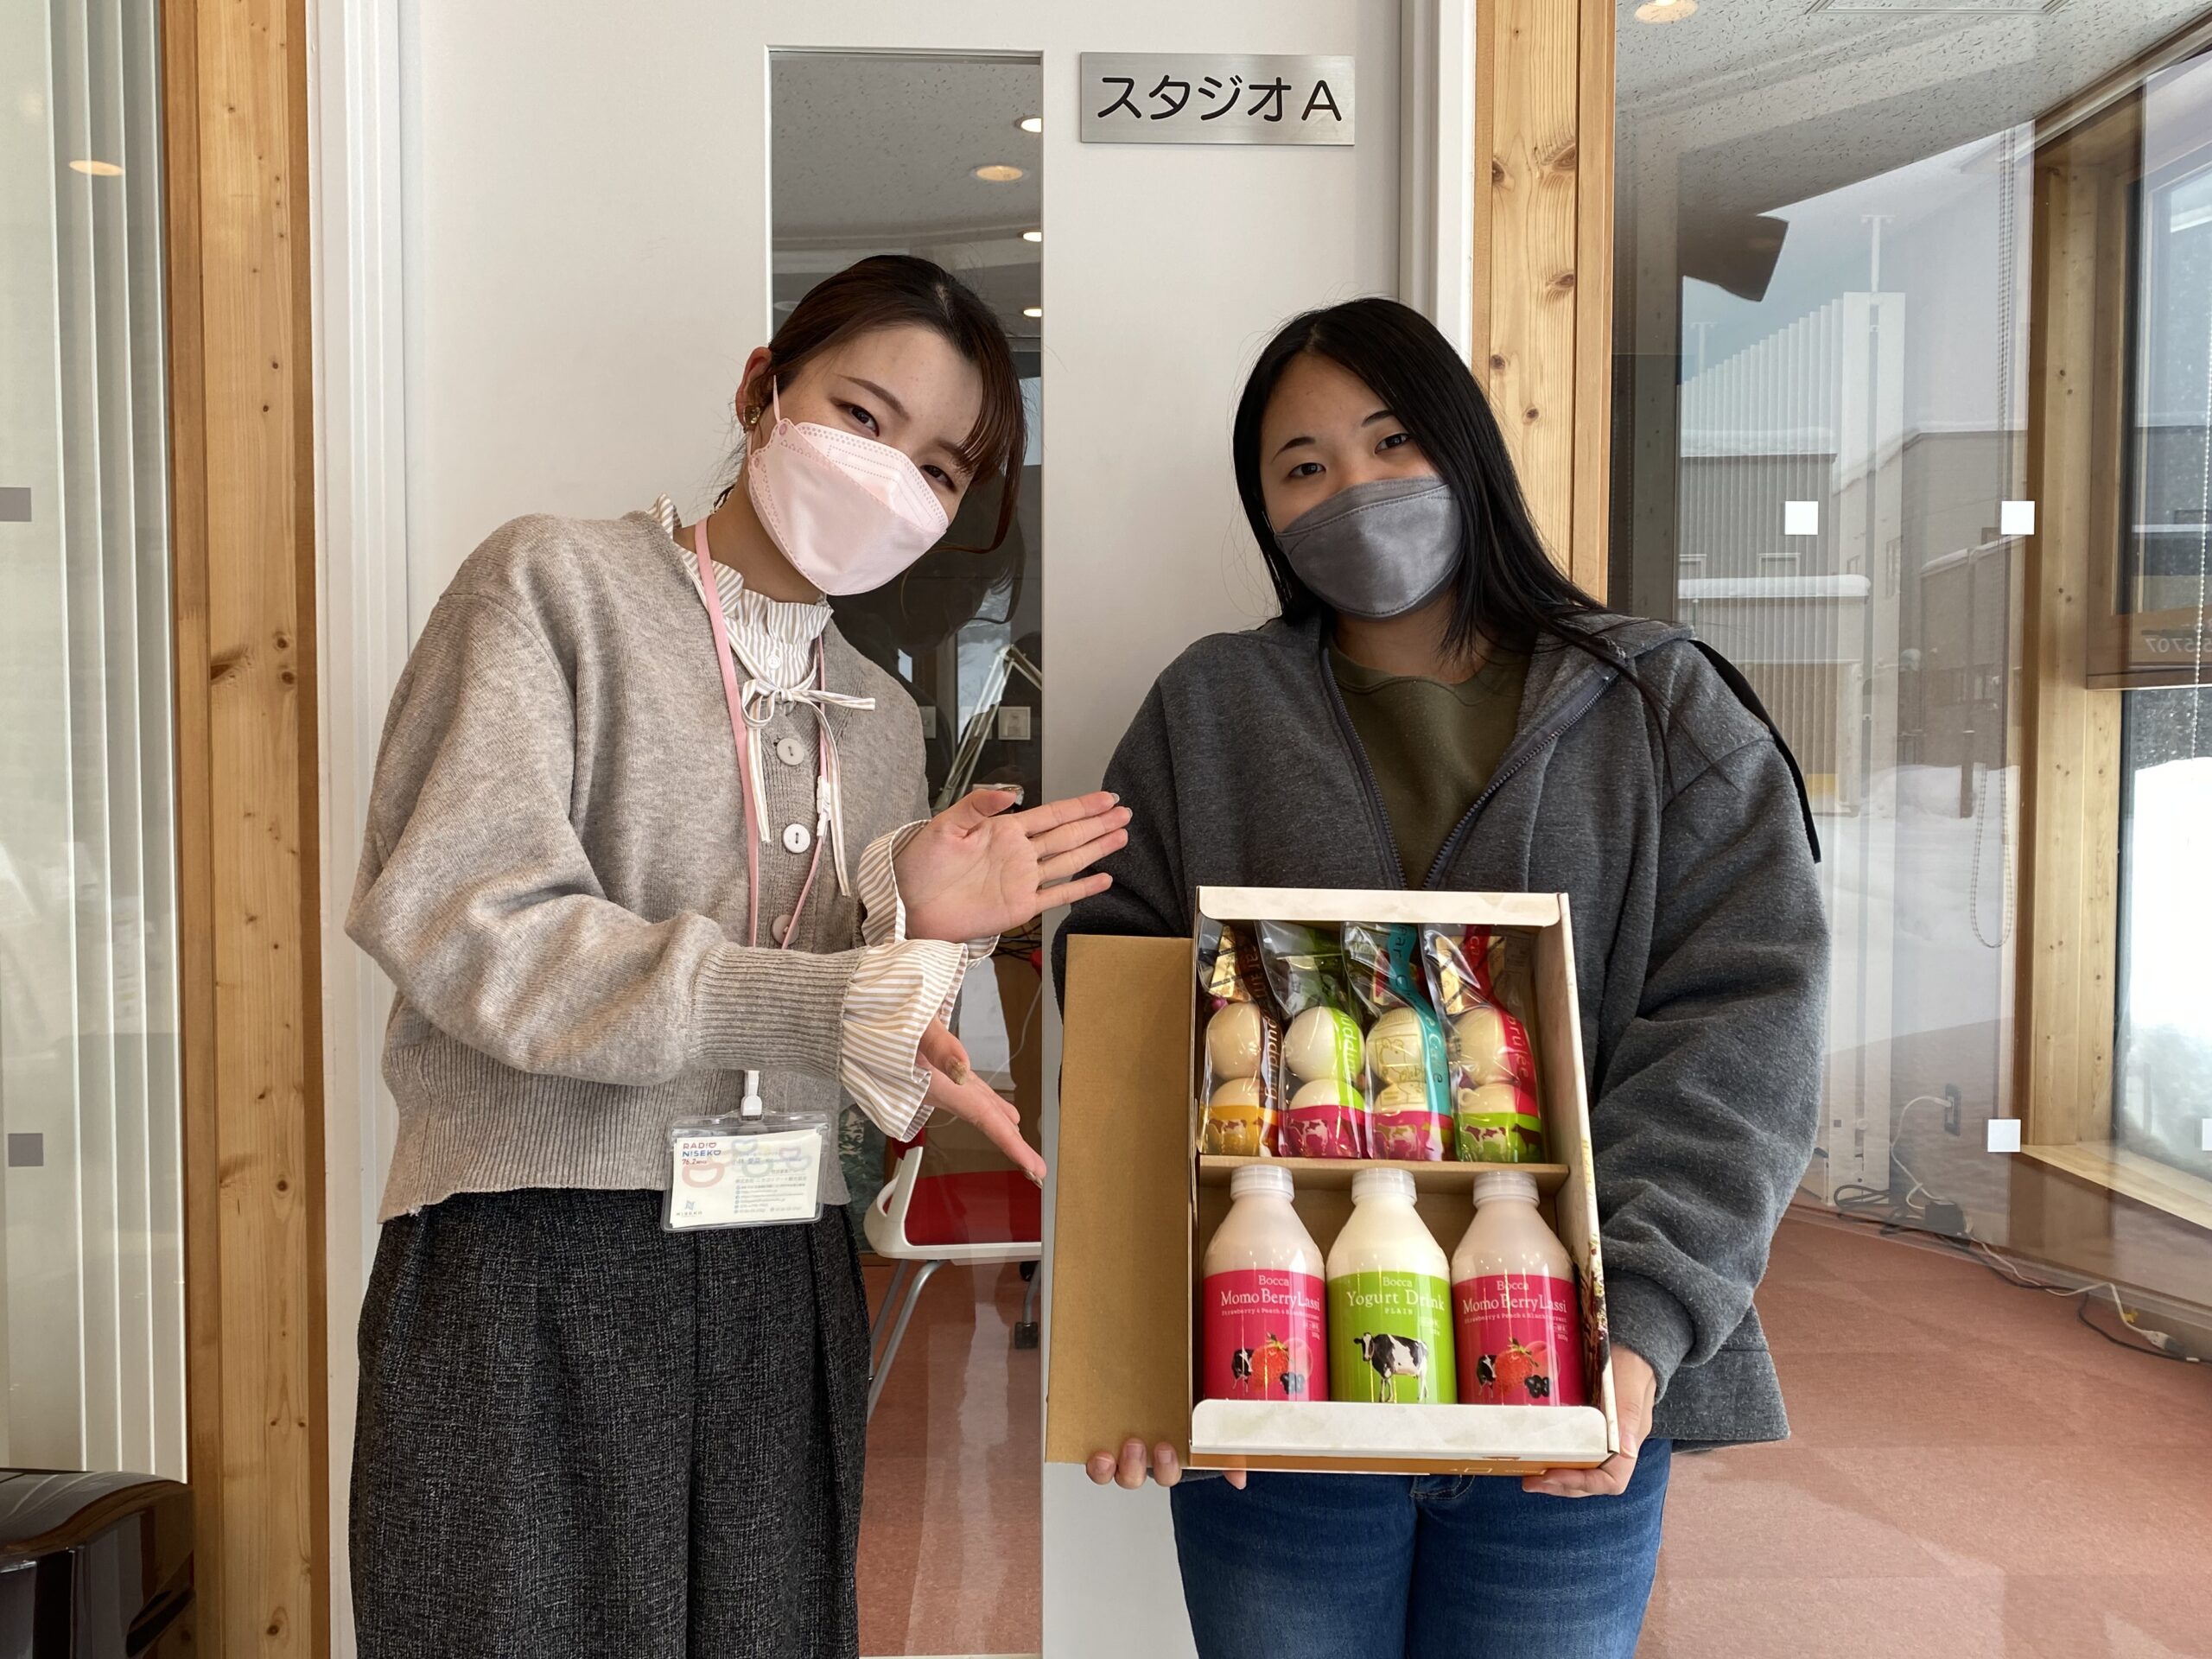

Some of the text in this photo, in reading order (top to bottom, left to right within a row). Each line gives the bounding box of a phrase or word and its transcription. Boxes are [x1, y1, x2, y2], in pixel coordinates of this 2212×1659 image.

[1263, 1014, 1280, 1100] pudding
[683, 1141, 717, 1150] RADIO
[1258, 1274, 1290, 1286] Bocca
[1382, 1276, 1413, 1287] Bocca
[1497, 1281, 1529, 1291] Bocca
[1220, 1287, 1320, 1312] Momo Berry Lassi
[1346, 1289, 1445, 1312] Yogurt Drink
[1462, 1294, 1567, 1314] Momo Berry Lassi
